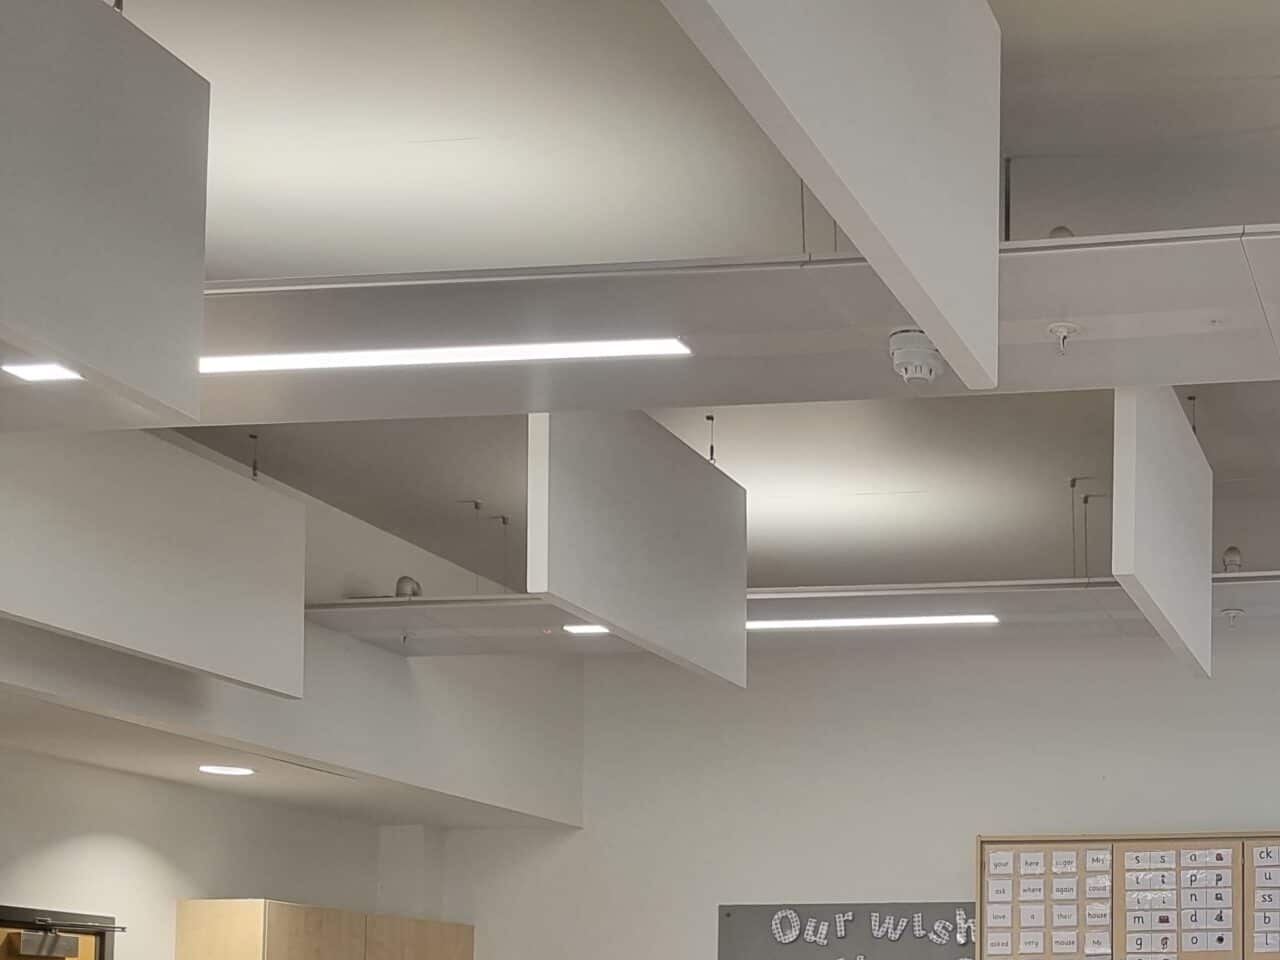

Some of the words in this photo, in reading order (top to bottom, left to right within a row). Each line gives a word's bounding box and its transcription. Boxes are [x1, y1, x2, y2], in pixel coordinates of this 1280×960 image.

[1259, 848, 1272, 859] ck
[1135, 856, 1140, 864] s
[1190, 874, 1197, 885] p
[1216, 874, 1222, 885] p
[1265, 872, 1272, 880] u
[1055, 887, 1074, 895] again
[1190, 893, 1197, 901] n
[1262, 894, 1273, 903] ss
[1134, 916, 1144, 924] m
[1190, 910, 1197, 922] d
[1264, 912, 1271, 924] b
[771, 908, 854, 946] Our
[870, 907, 976, 945] wish
[1136, 937, 1142, 950] g
[1191, 936, 1198, 944] o
